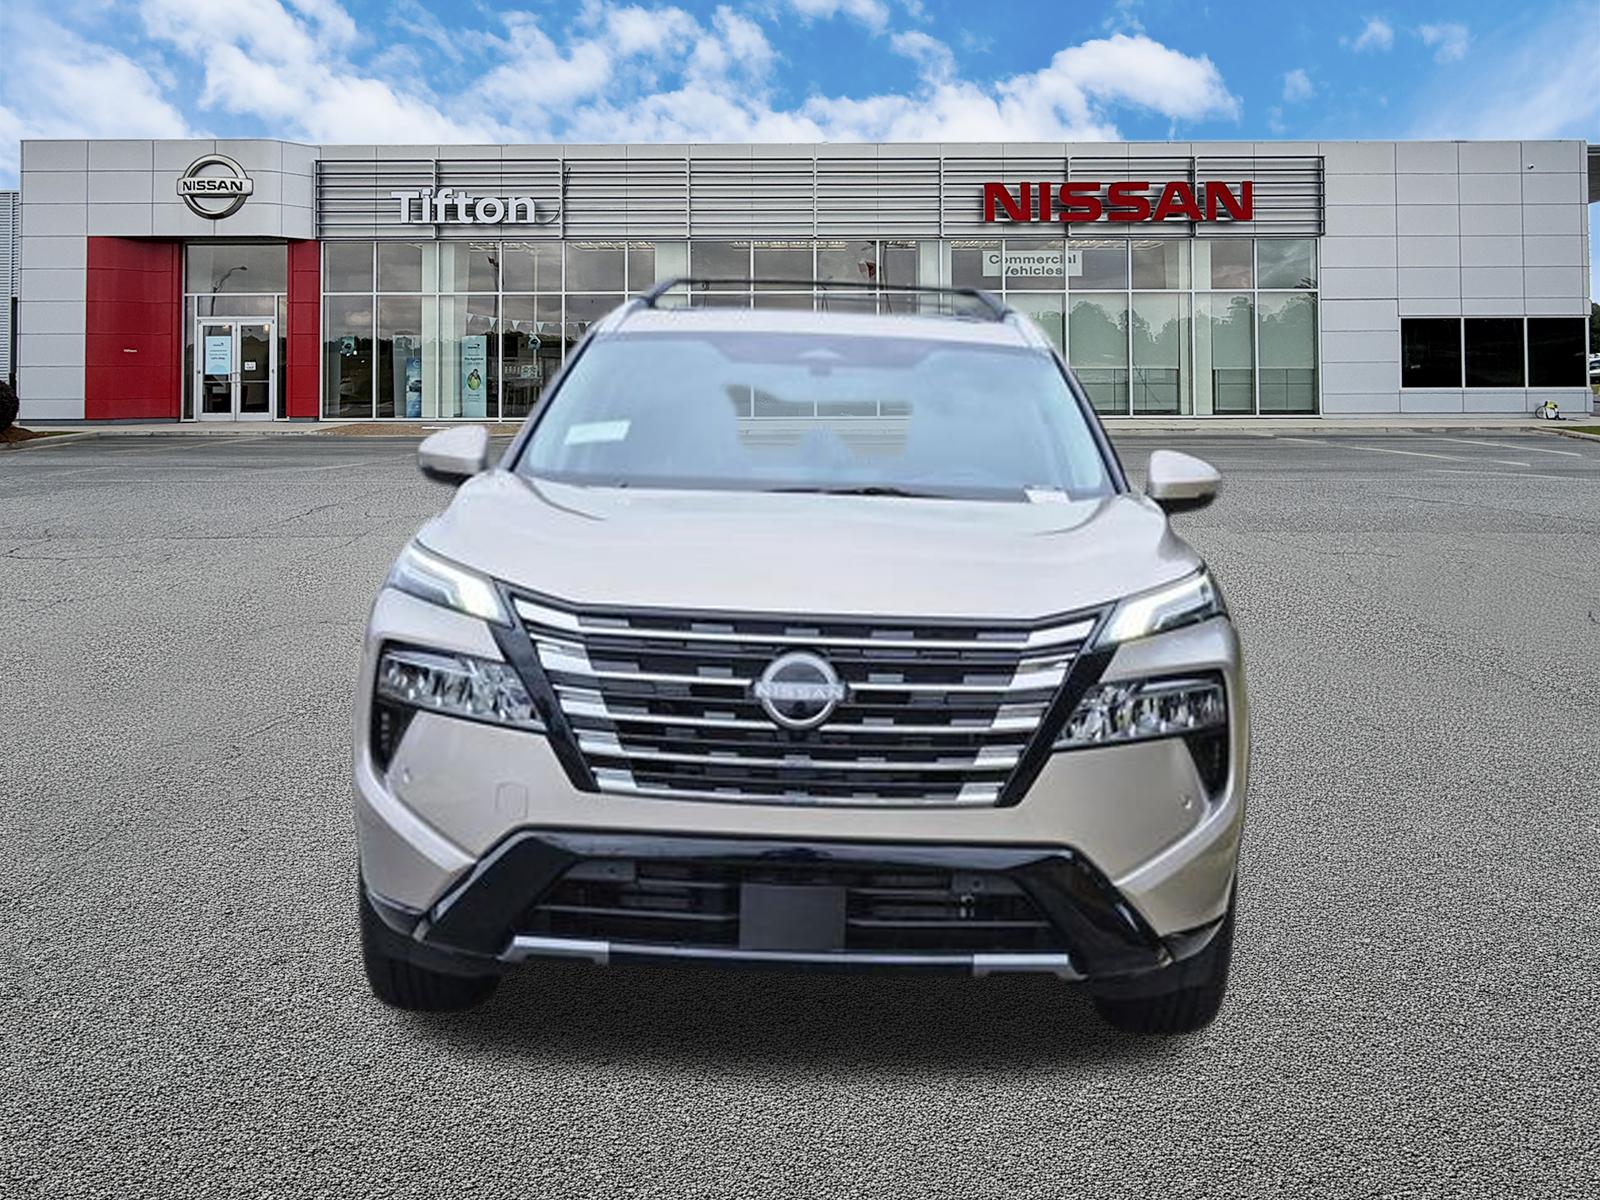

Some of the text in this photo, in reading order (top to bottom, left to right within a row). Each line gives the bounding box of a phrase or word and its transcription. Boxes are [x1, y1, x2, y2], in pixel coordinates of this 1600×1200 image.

[183, 180, 243, 191] NISSAN
[984, 181, 1253, 222] NISSAN
[391, 188, 536, 224] Tifton
